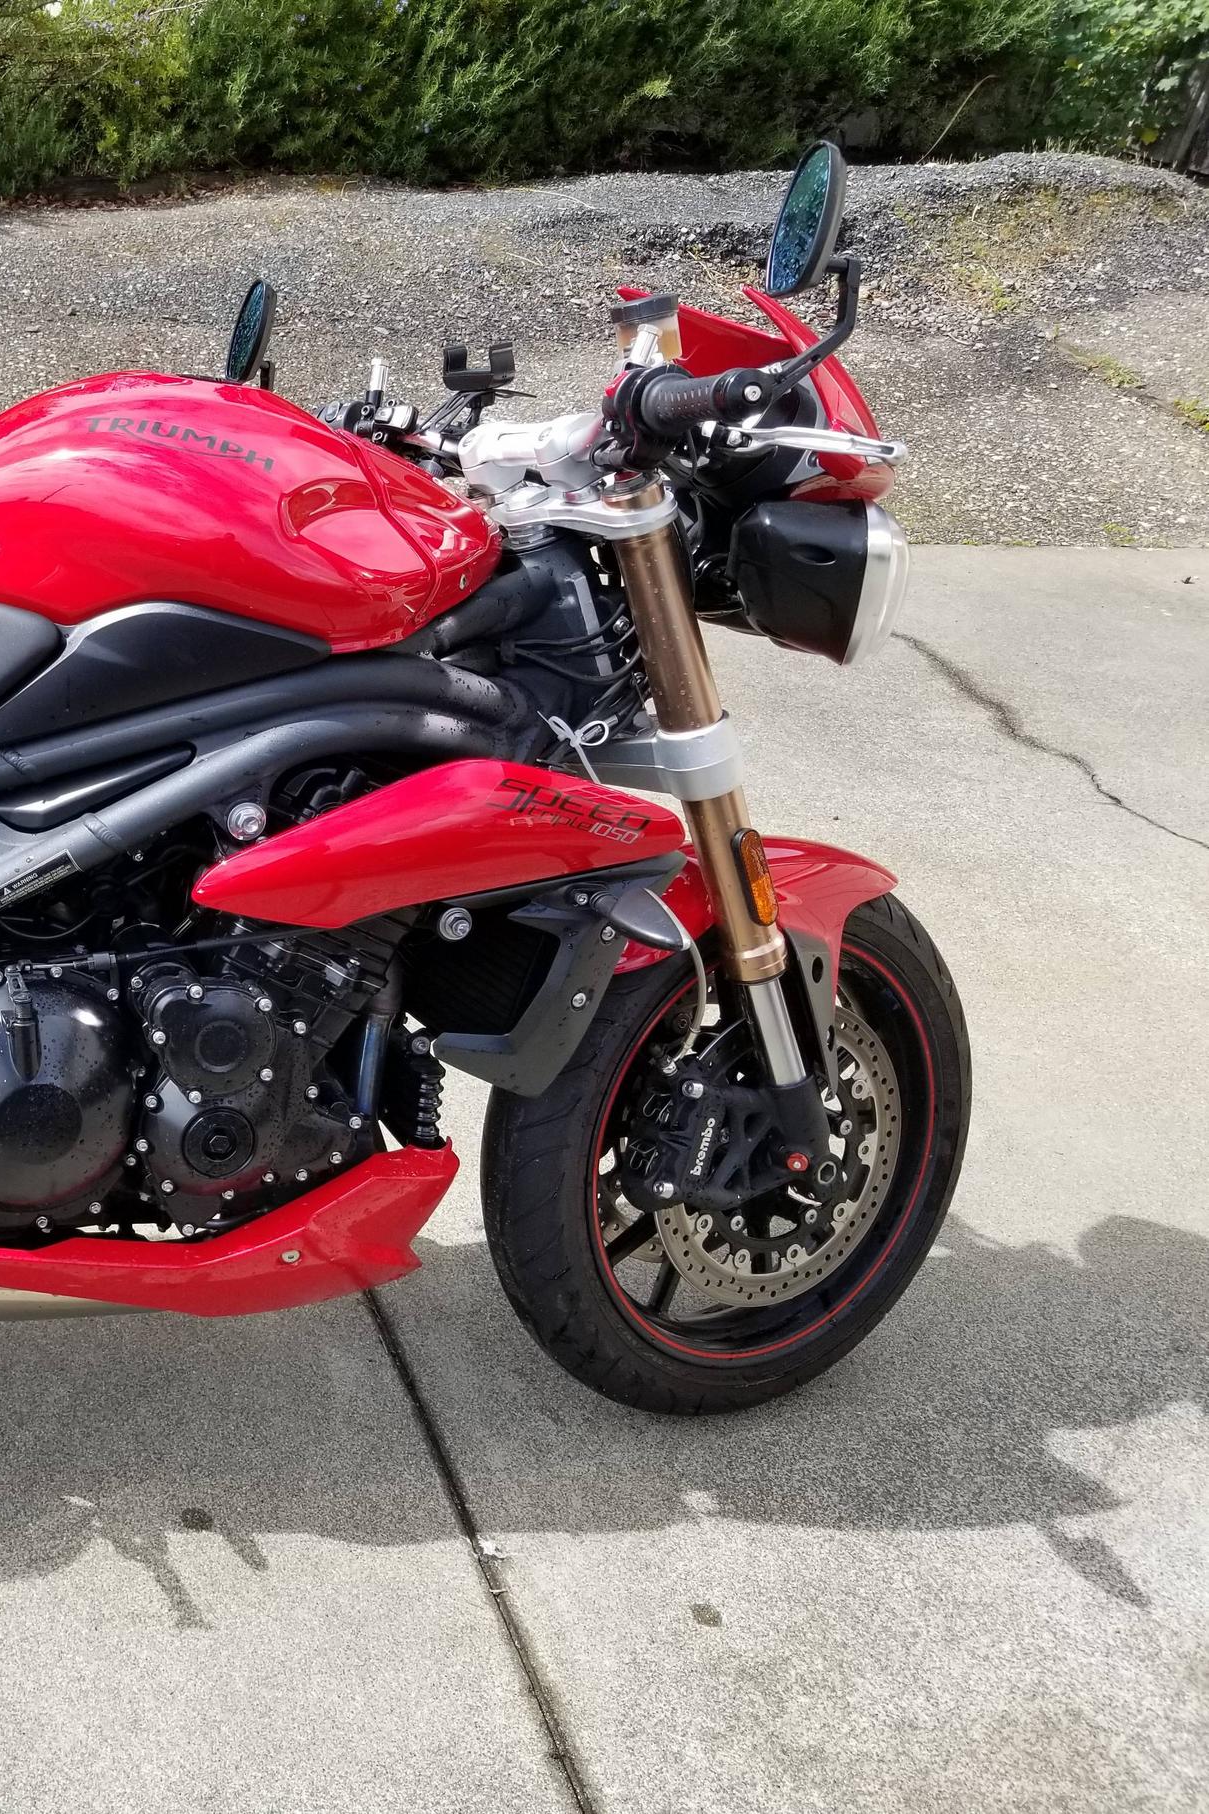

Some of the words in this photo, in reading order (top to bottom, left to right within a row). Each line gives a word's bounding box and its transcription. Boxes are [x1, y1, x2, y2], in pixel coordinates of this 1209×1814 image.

[86, 417, 274, 472] TRIUMPH
[486, 778, 652, 832] SPEED
[528, 805, 590, 831] triple
[589, 821, 639, 845] 1050
[12, 873, 38, 889] WARNING
[690, 1118, 716, 1176] brembo
